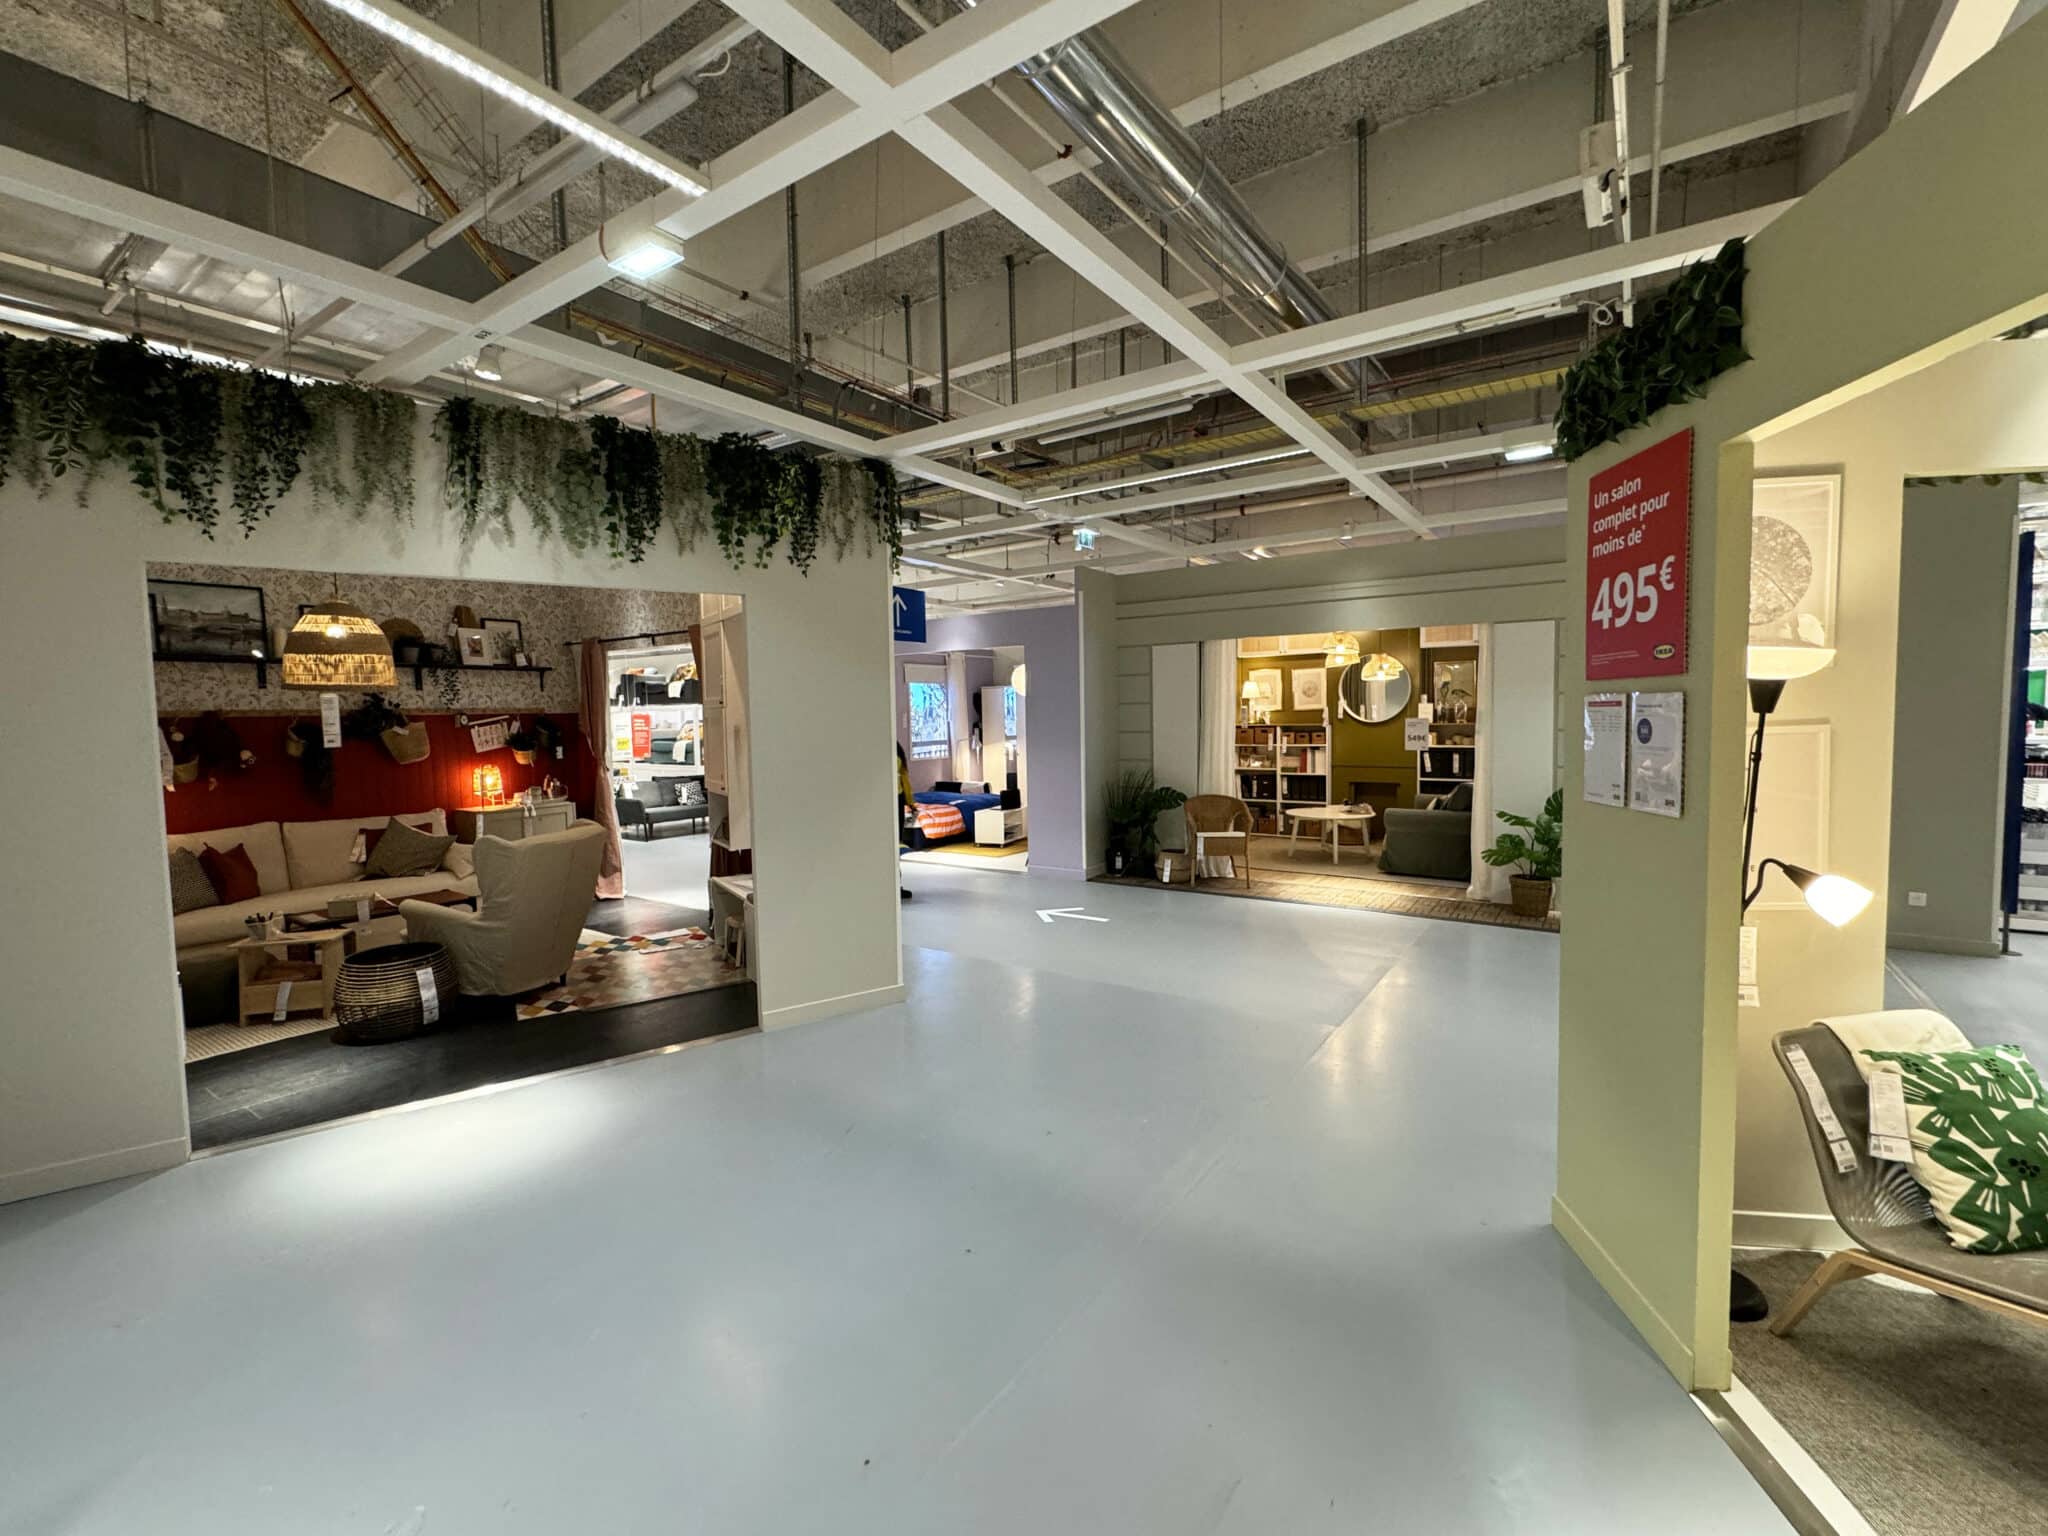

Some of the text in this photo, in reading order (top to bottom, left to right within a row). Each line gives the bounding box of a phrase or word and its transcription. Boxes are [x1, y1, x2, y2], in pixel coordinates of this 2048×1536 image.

[1594, 477, 1641, 508] Un salon
[1593, 491, 1670, 533] complet pour
[1592, 535, 1625, 558] moins
[1592, 555, 1676, 629] 495€
